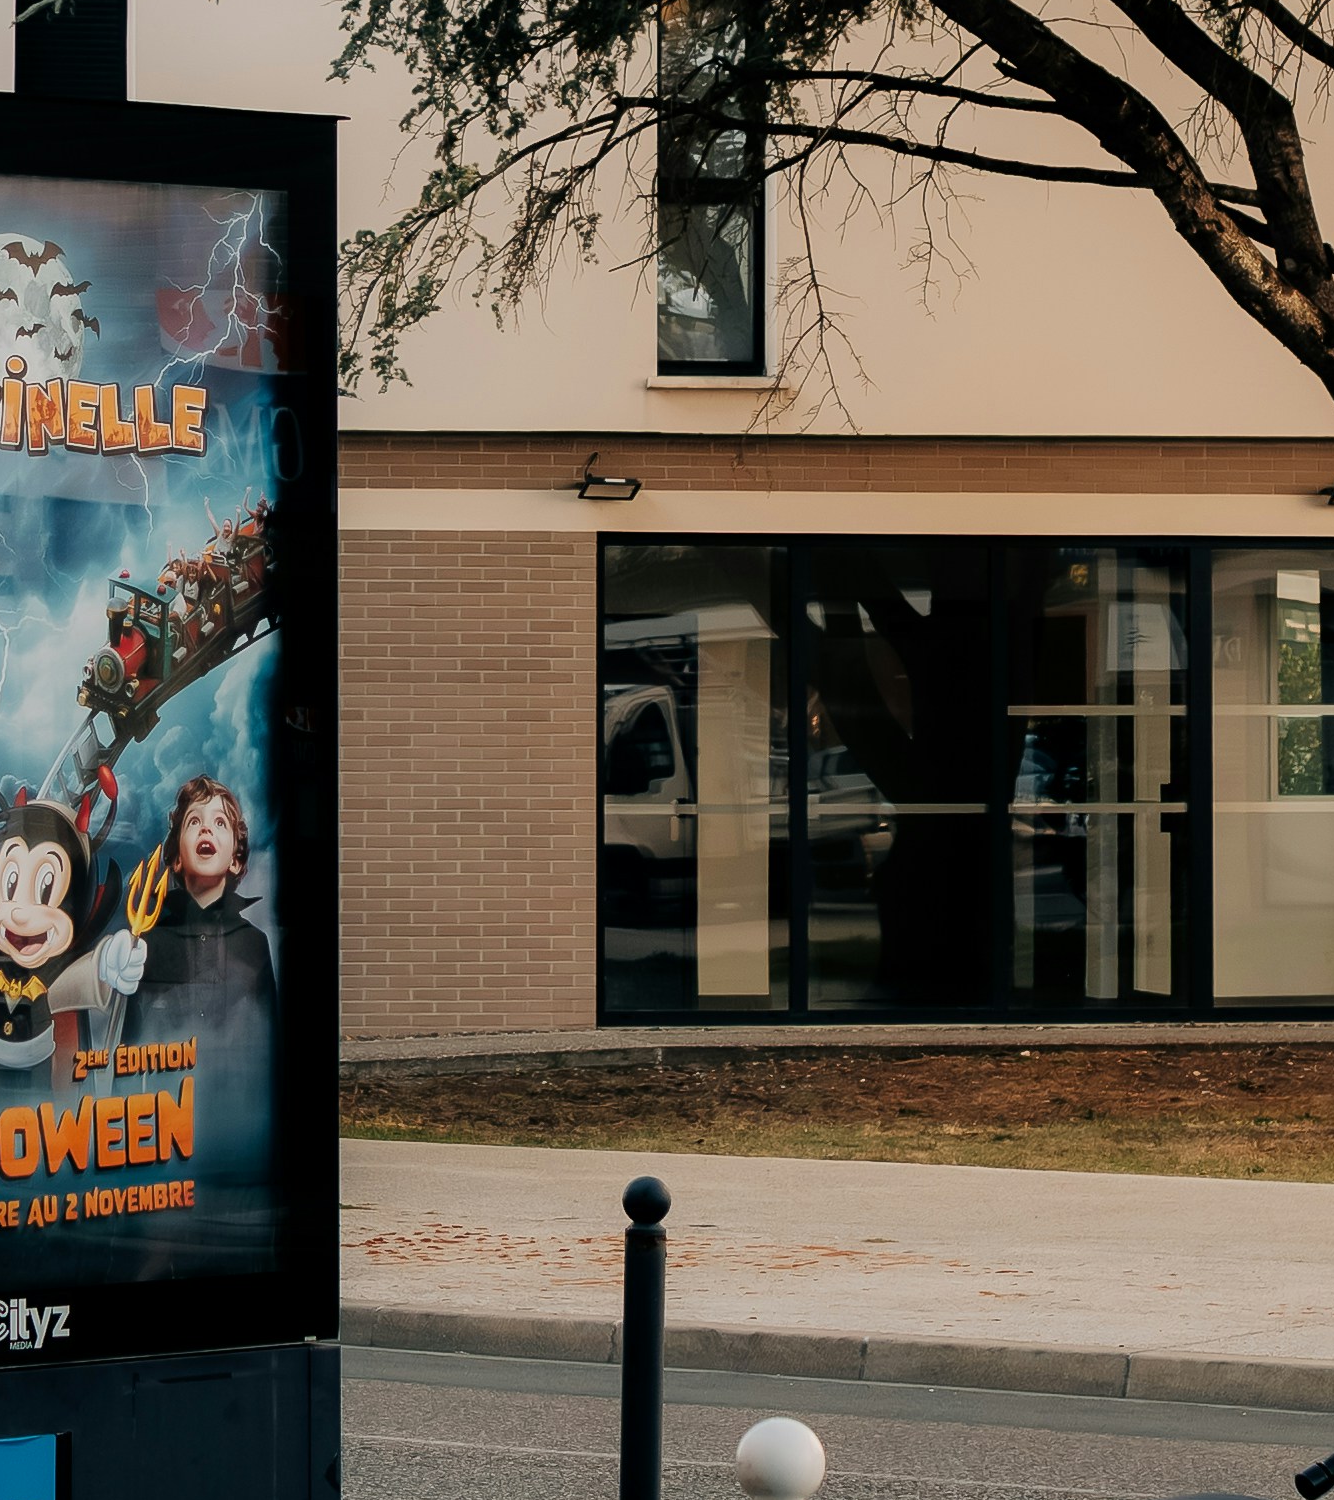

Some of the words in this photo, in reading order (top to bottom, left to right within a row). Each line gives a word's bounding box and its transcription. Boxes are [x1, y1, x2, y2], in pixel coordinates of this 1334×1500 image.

[115, 1036, 198, 1078] ÉDITION
[27, 1195, 59, 1228] AU
[65, 1193, 79, 1222] 2
[85, 1180, 195, 1218] NOVEMBRE
[9, 1341, 33, 1350] MEDIA
